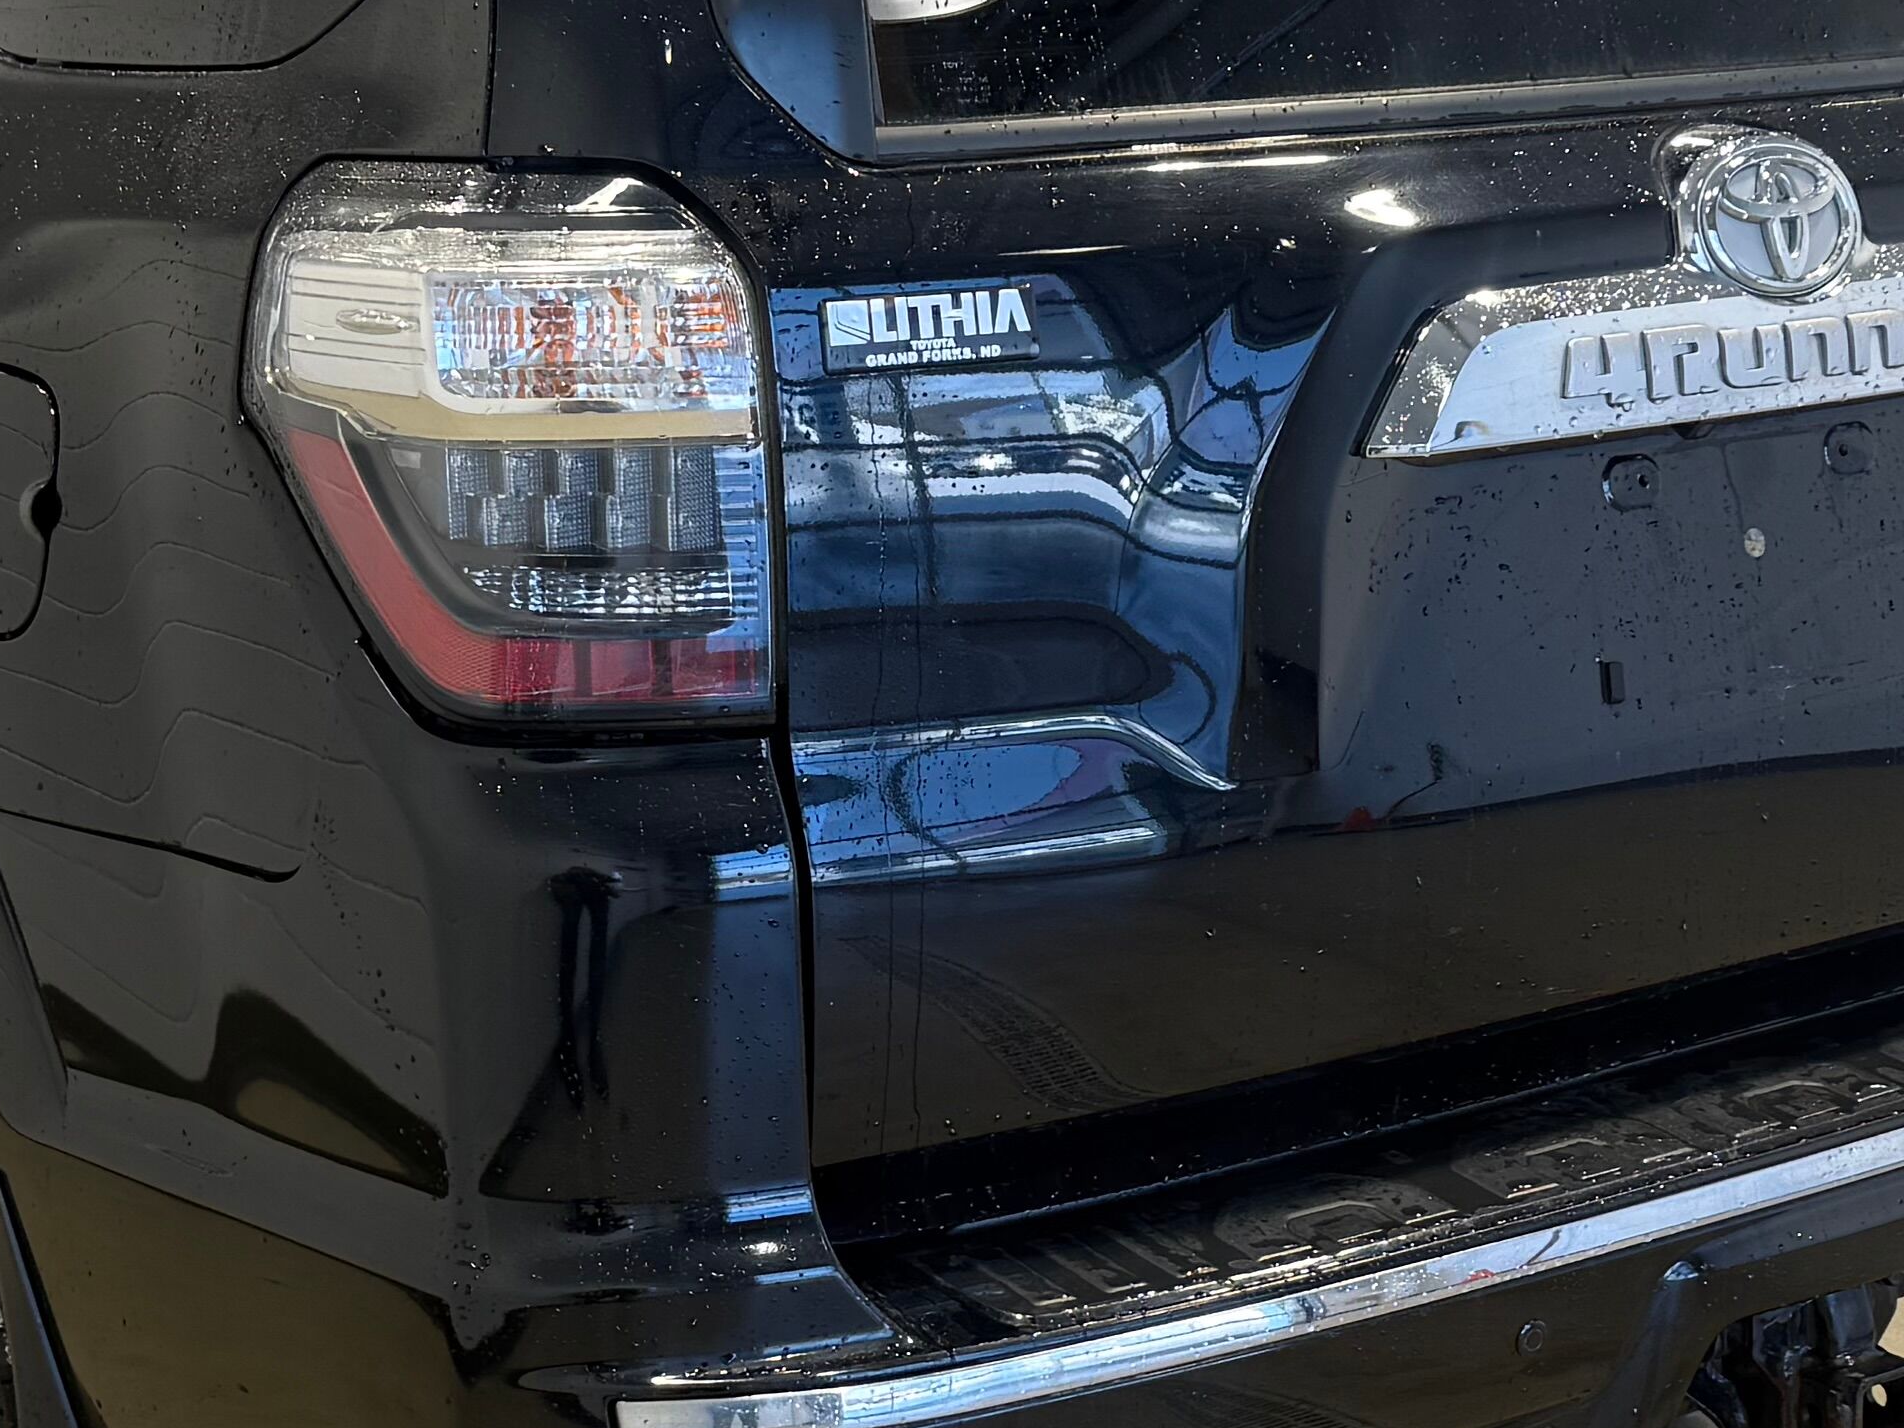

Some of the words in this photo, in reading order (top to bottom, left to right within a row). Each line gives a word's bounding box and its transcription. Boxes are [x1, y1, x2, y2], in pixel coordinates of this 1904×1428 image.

[870, 288, 1032, 343] LITHIA
[865, 350, 919, 367] GRAND
[980, 344, 1002, 359] ND
[910, 337, 957, 351] TOYOTA
